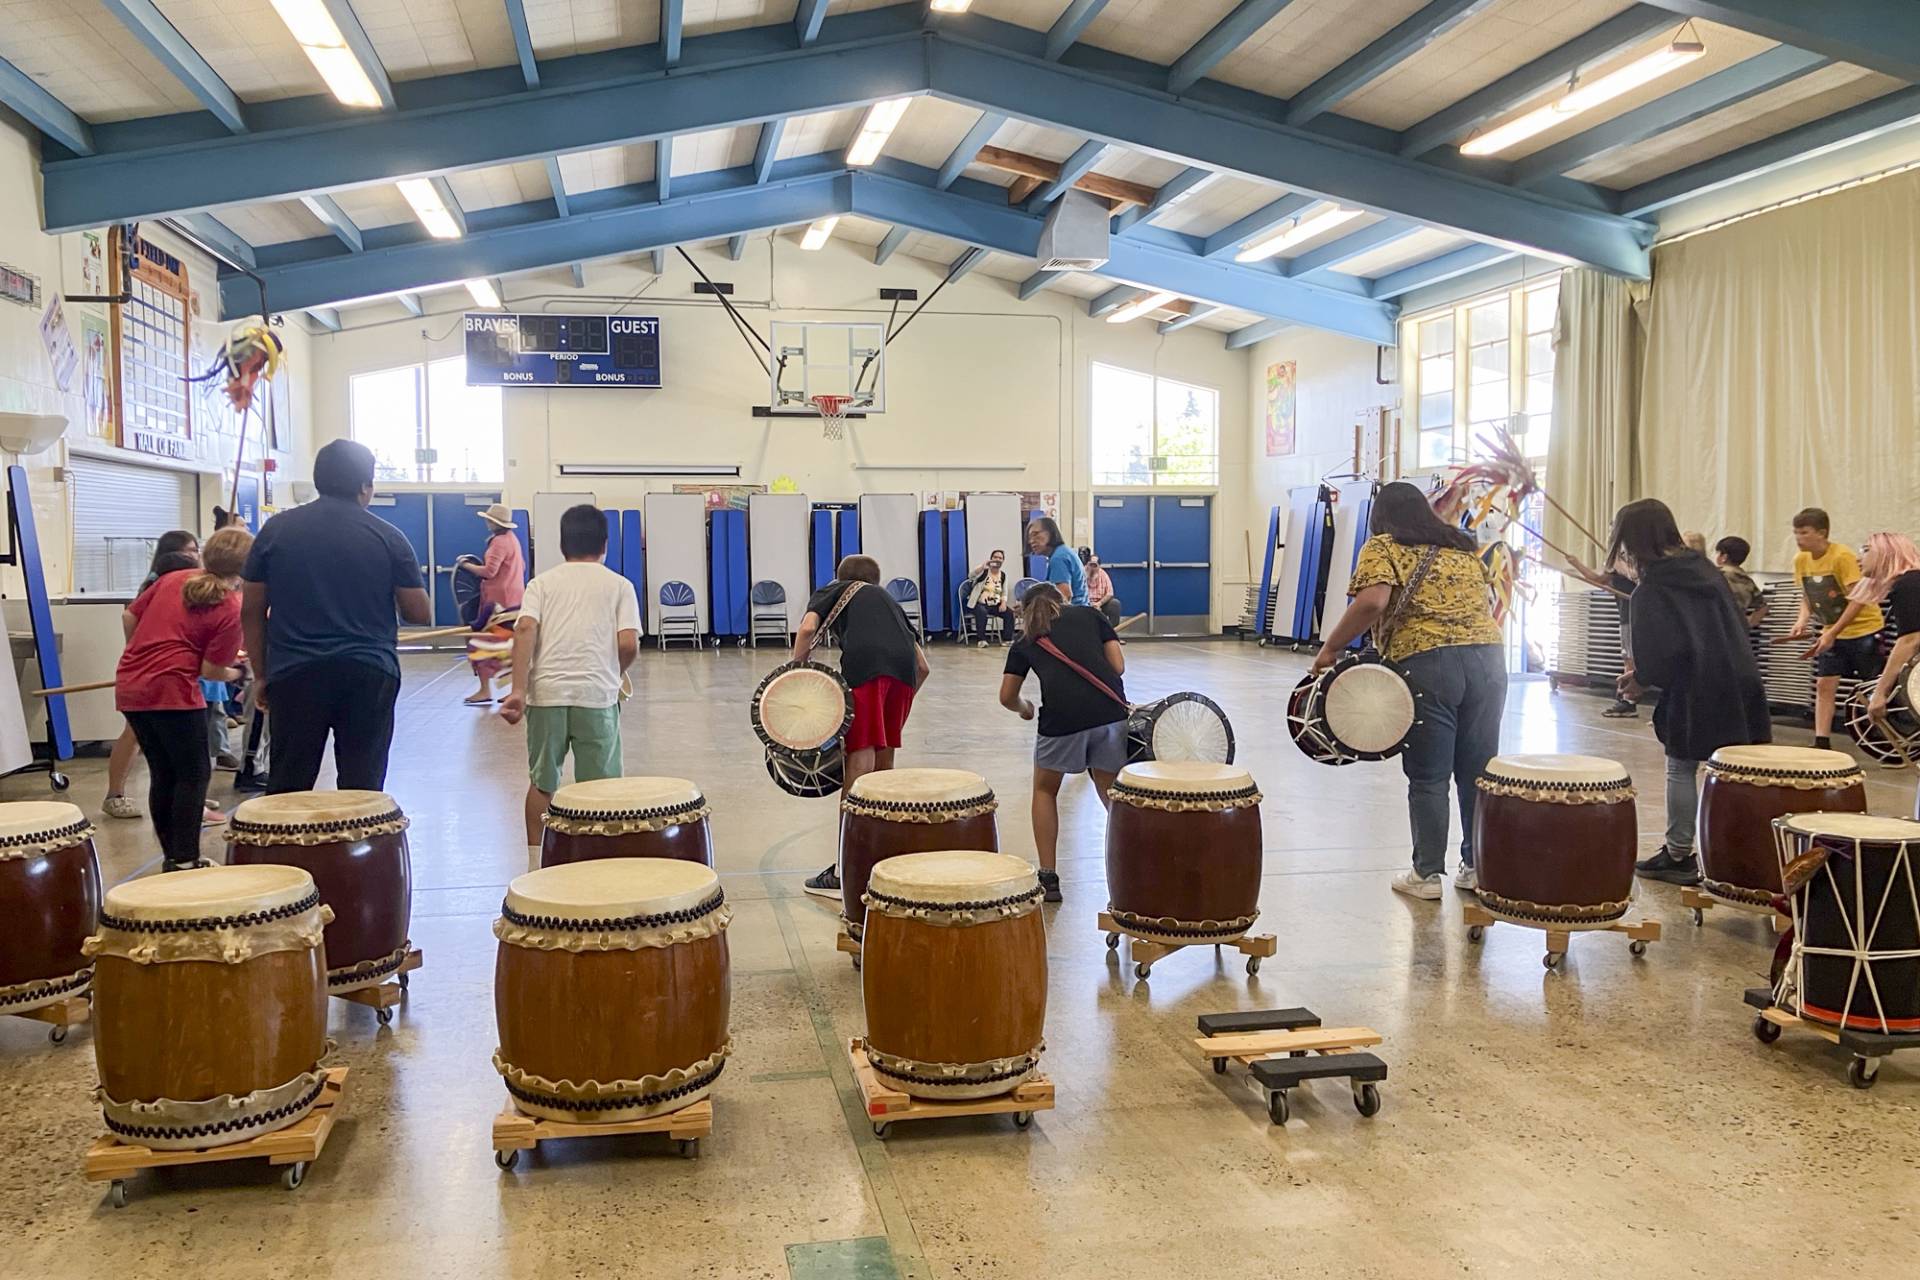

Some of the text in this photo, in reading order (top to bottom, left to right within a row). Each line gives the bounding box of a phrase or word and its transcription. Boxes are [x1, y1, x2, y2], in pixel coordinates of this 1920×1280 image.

[465, 317, 517, 331] BRAVES
[611, 320, 658, 334] GUEST
[503, 372, 534, 381] BONUS
[595, 373, 625, 382] BONUS
